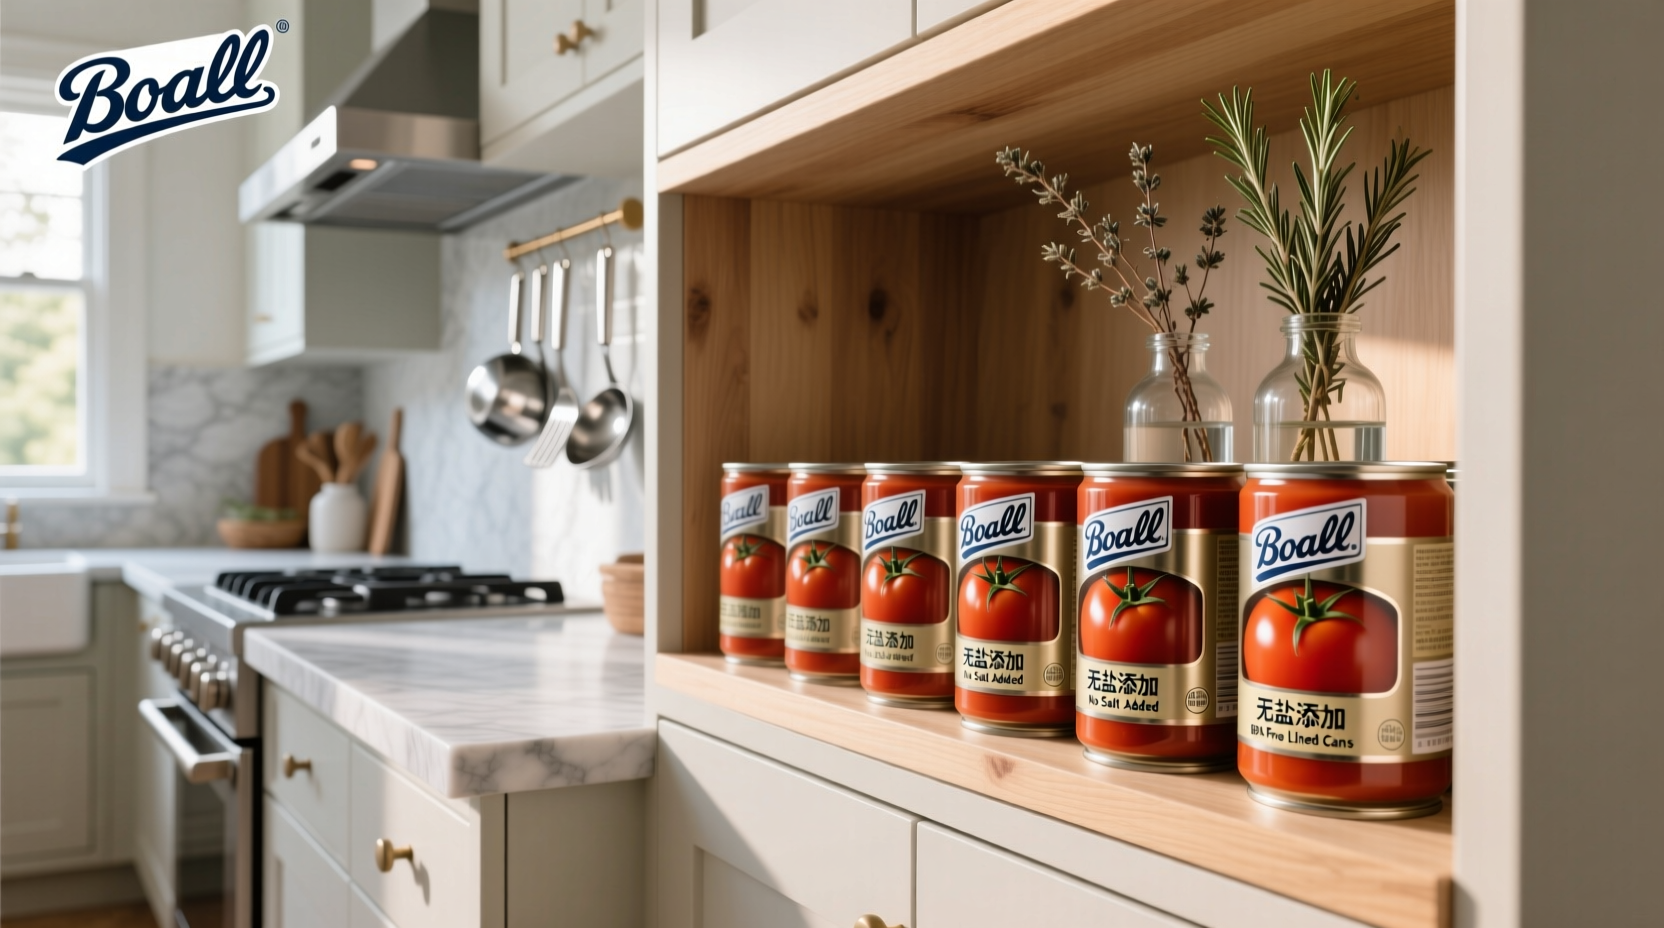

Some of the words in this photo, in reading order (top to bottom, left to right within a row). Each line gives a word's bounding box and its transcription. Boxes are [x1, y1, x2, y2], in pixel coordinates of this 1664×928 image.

[963, 647, 1024, 671] 无盐添加
[1087, 669, 1159, 696] 无盐添加
[1256, 697, 1346, 730] 无盐添加
[1323, 734, 1355, 749] Cans
